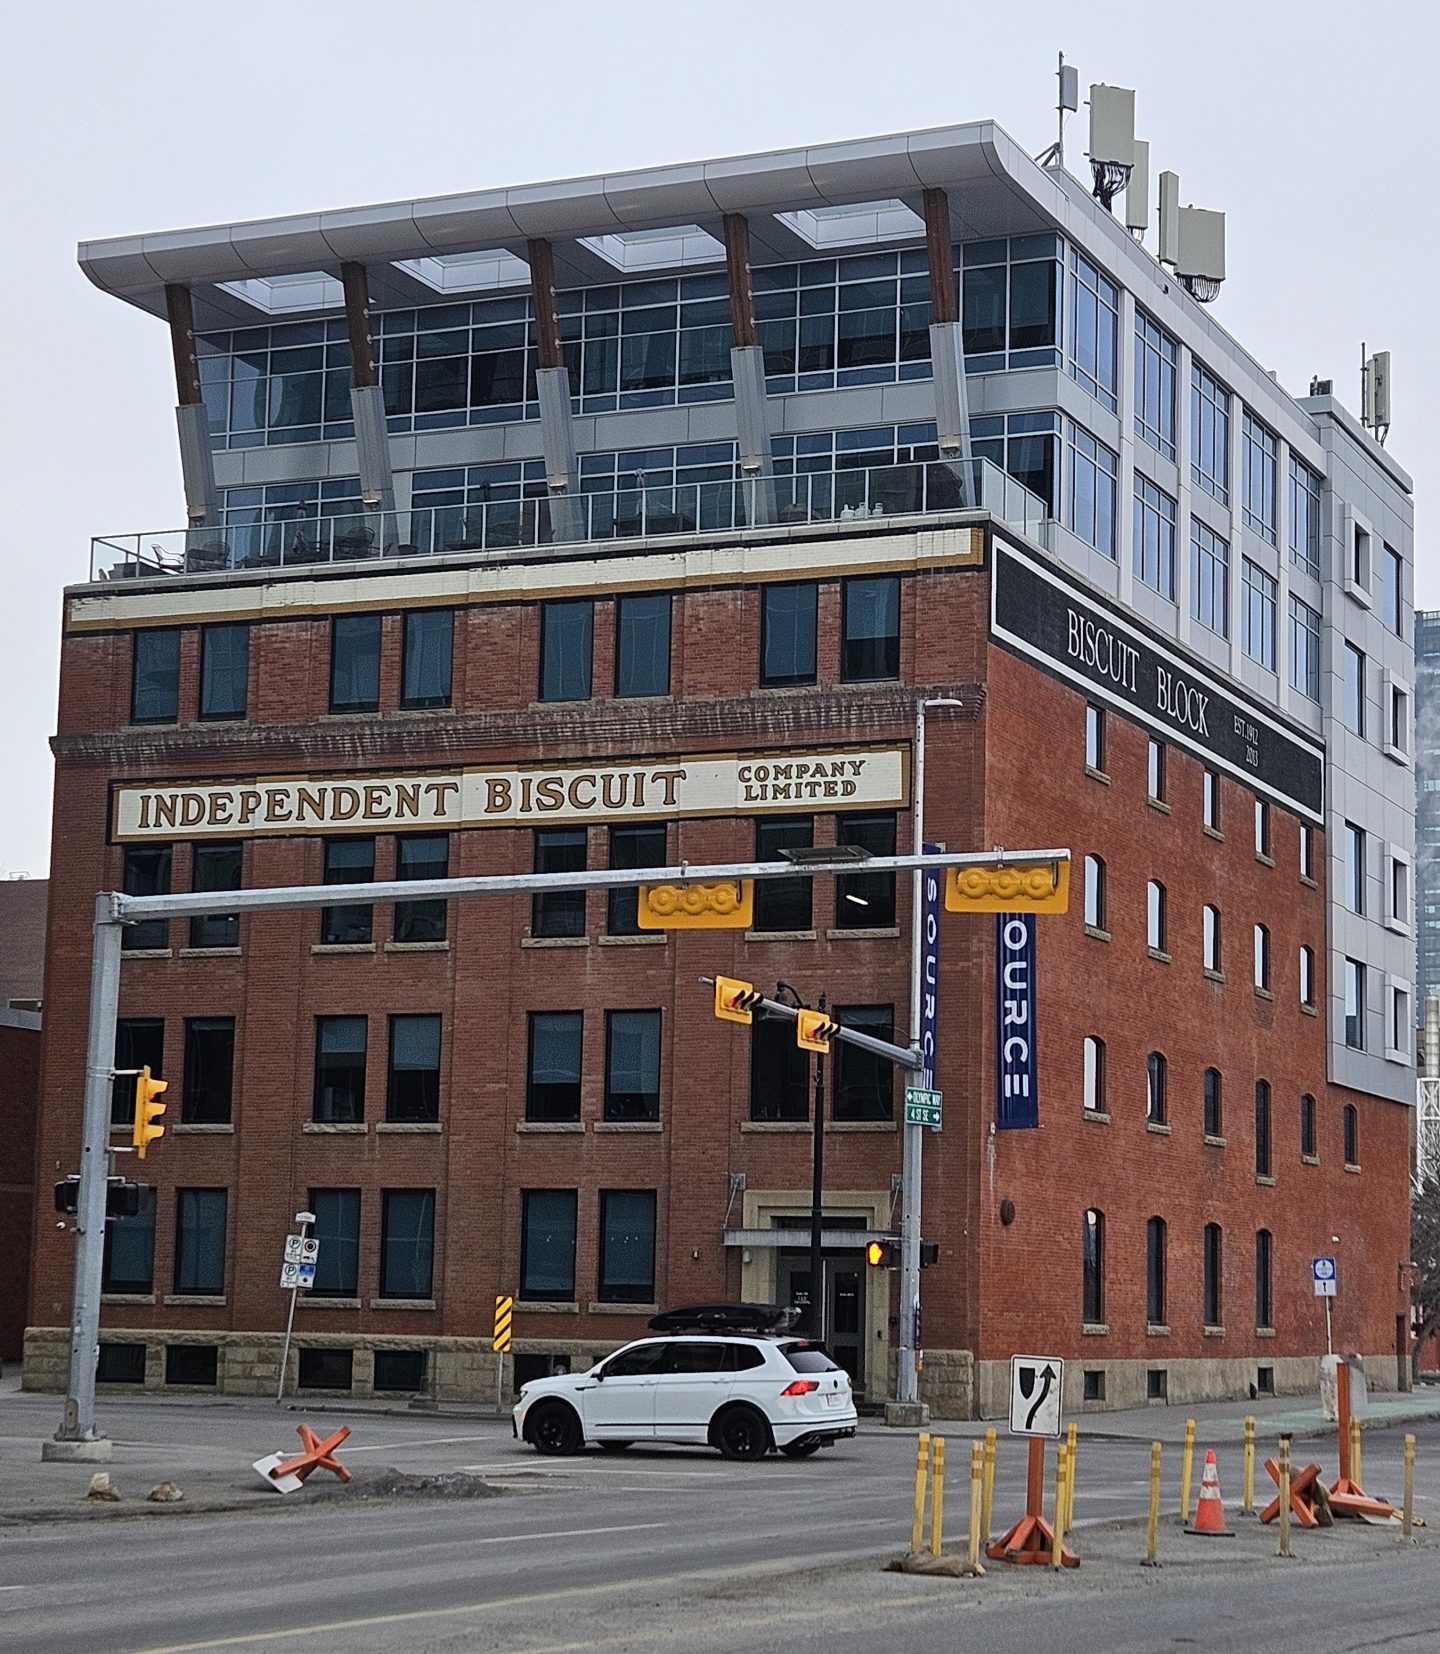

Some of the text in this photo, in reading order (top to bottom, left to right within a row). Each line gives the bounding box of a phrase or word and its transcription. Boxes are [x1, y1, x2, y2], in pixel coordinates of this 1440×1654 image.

[1067, 608, 1210, 738] BISCUIT BLOCK
[138, 769, 687, 830] INDEPENDENT BISCUIT
[738, 760, 866, 783] COMPANY
[743, 780, 857, 802] LIMITED
[923, 876, 937, 1090] SOURCE
[1003, 919, 1029, 1098] OURCE
[911, 1108, 915, 1120] 4
